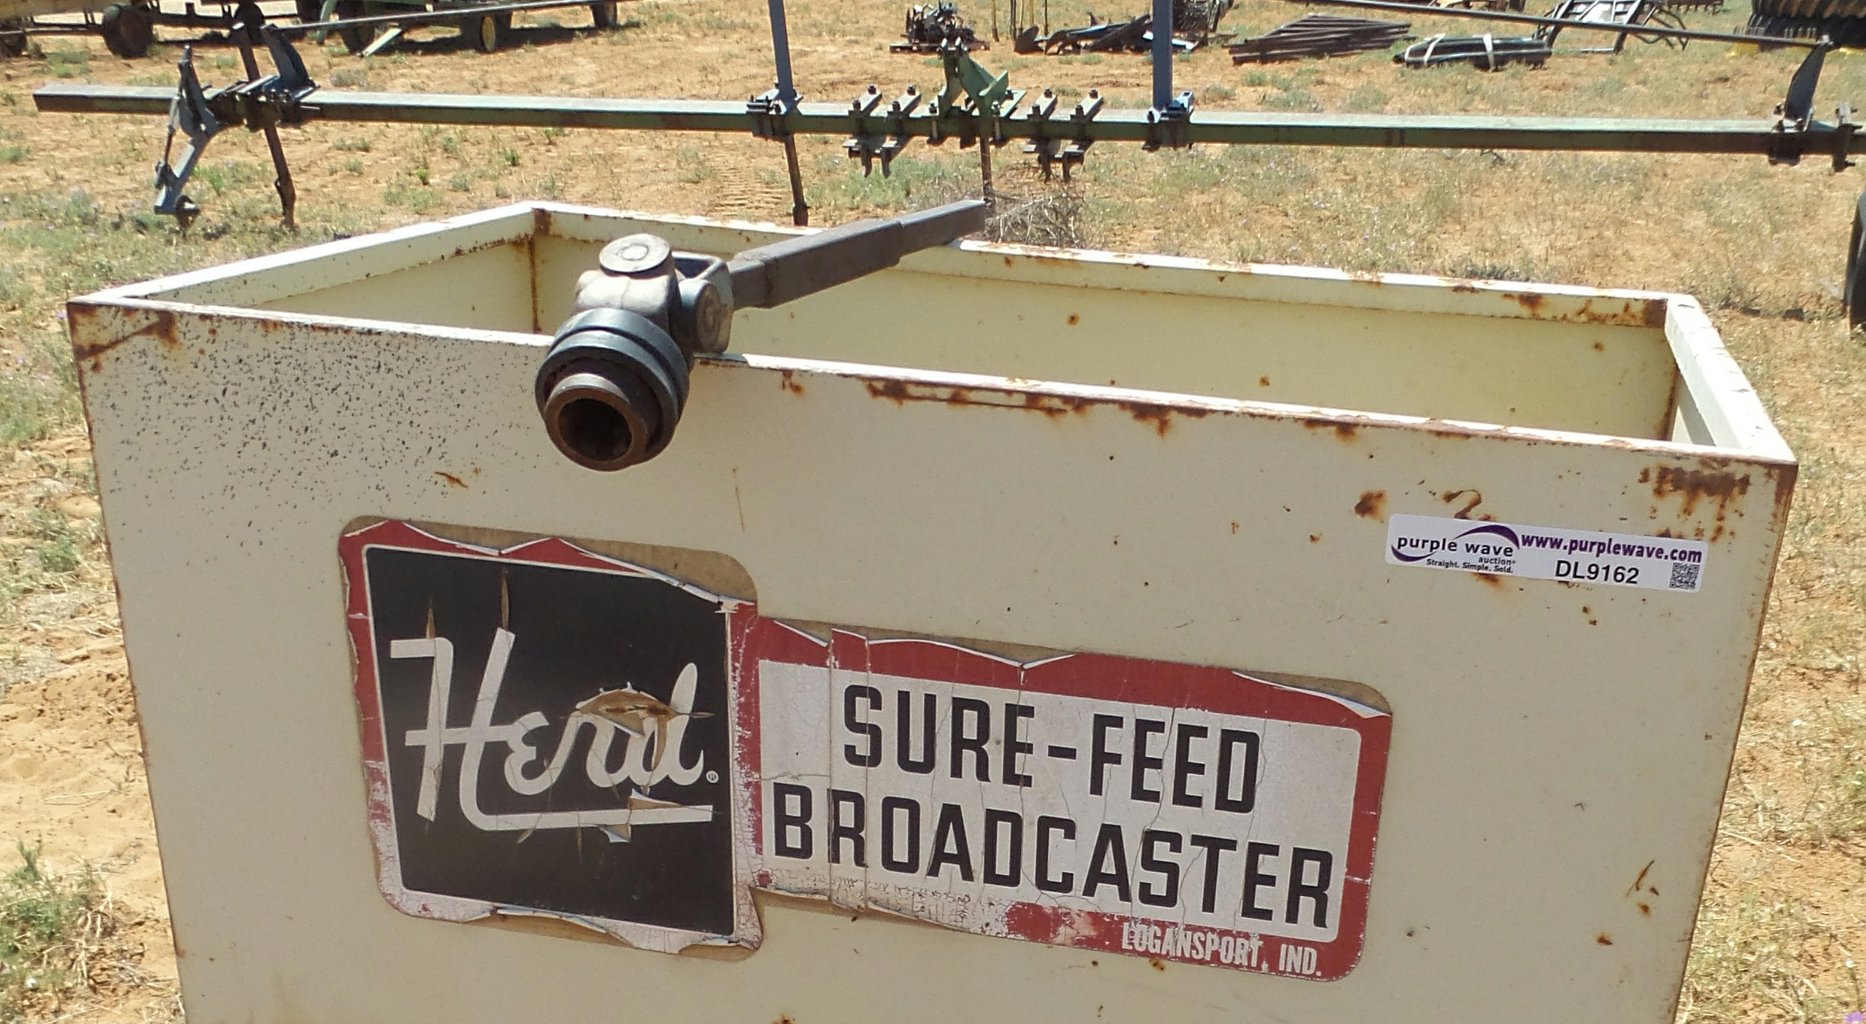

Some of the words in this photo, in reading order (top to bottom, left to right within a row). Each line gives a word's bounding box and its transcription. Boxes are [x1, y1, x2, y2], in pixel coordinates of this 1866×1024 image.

[1397, 537, 1458, 552] purple
[1465, 542, 1514, 557] wave
[1521, 533, 1702, 563] www.purplewave.com
[1426, 558, 1460, 568] Straight.
[1462, 562, 1492, 571] Simple.
[1555, 560, 1639, 584] DL9162
[843, 684, 1260, 814] SURE-FEED
[773, 782, 1333, 928] BROADCASTER
[1279, 943, 1322, 977] IND.
